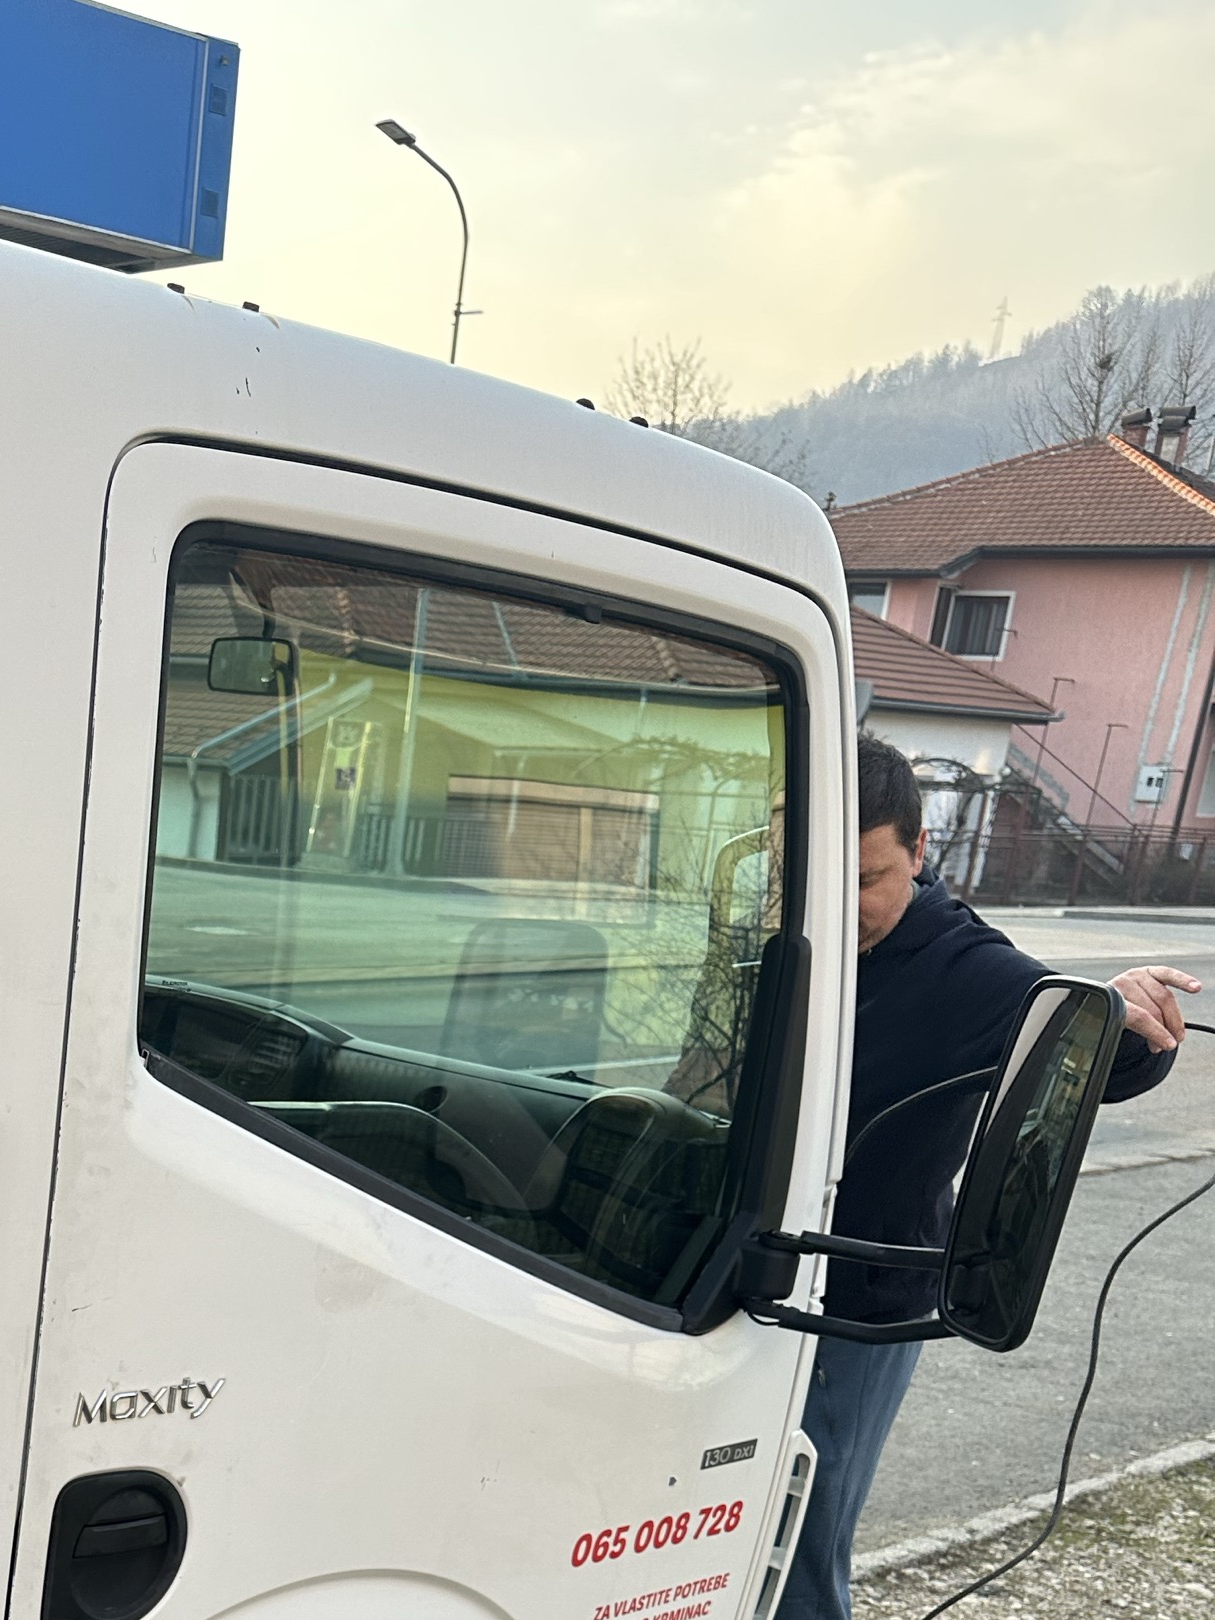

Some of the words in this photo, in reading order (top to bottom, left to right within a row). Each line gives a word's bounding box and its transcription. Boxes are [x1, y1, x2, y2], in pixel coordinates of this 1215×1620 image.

[72, 1377, 227, 1428] Maxity
[704, 1446, 731, 1468] 130
[571, 1524, 631, 1568] 065
[634, 1511, 691, 1554] 008
[693, 1500, 744, 1540] 728
[613, 1587, 671, 1618] VLASTITE
[673, 1573, 730, 1600] POTREBE
